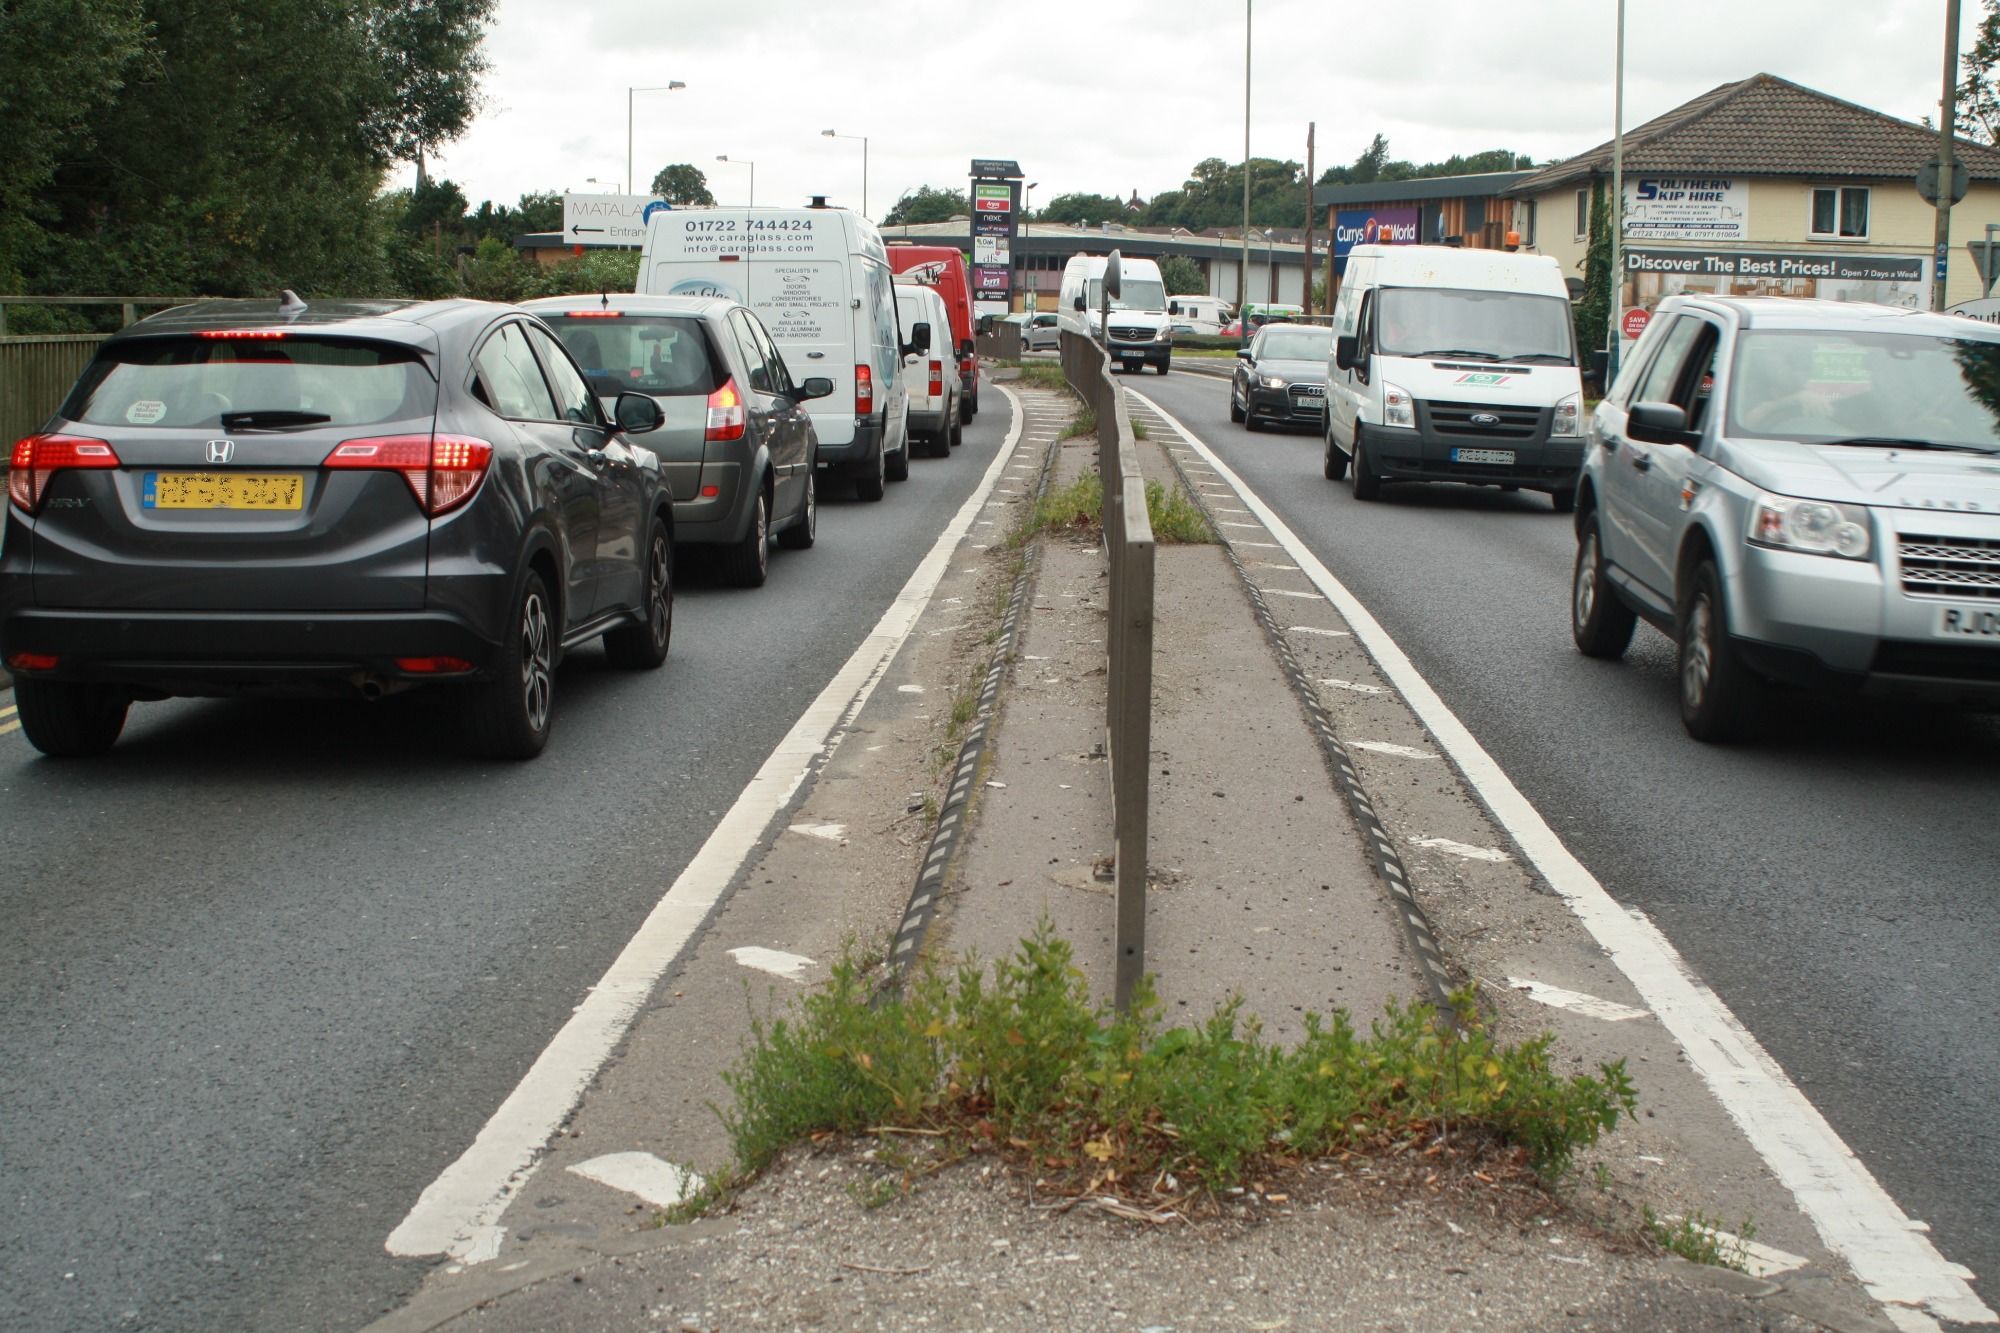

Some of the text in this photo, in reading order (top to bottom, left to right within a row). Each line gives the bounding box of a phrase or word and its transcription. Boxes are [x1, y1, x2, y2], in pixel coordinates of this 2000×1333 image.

[1688, 192, 1725, 201] HIRE
[572, 202, 643, 217] MATALA
[983, 214, 1002, 222] next
[610, 226, 645, 237] Entran
[685, 220, 813, 232] 01722 744424
[685, 234, 813, 243] www.caraglass.com
[1337, 225, 1364, 245] Currys
[1391, 224, 1416, 240] World
[684, 244, 814, 254] info@caraglass.com
[1627, 254, 1700, 272] Discover
[1704, 256, 1735, 273] The
[1739, 257, 1776, 274] Best
[1781, 258, 1835, 276] Prices!
[1840, 269, 1863, 279] Open
[1863, 269, 1869, 278] 7
[1870, 270, 1889, 280] Days
[1896, 270, 1919, 279] Week
